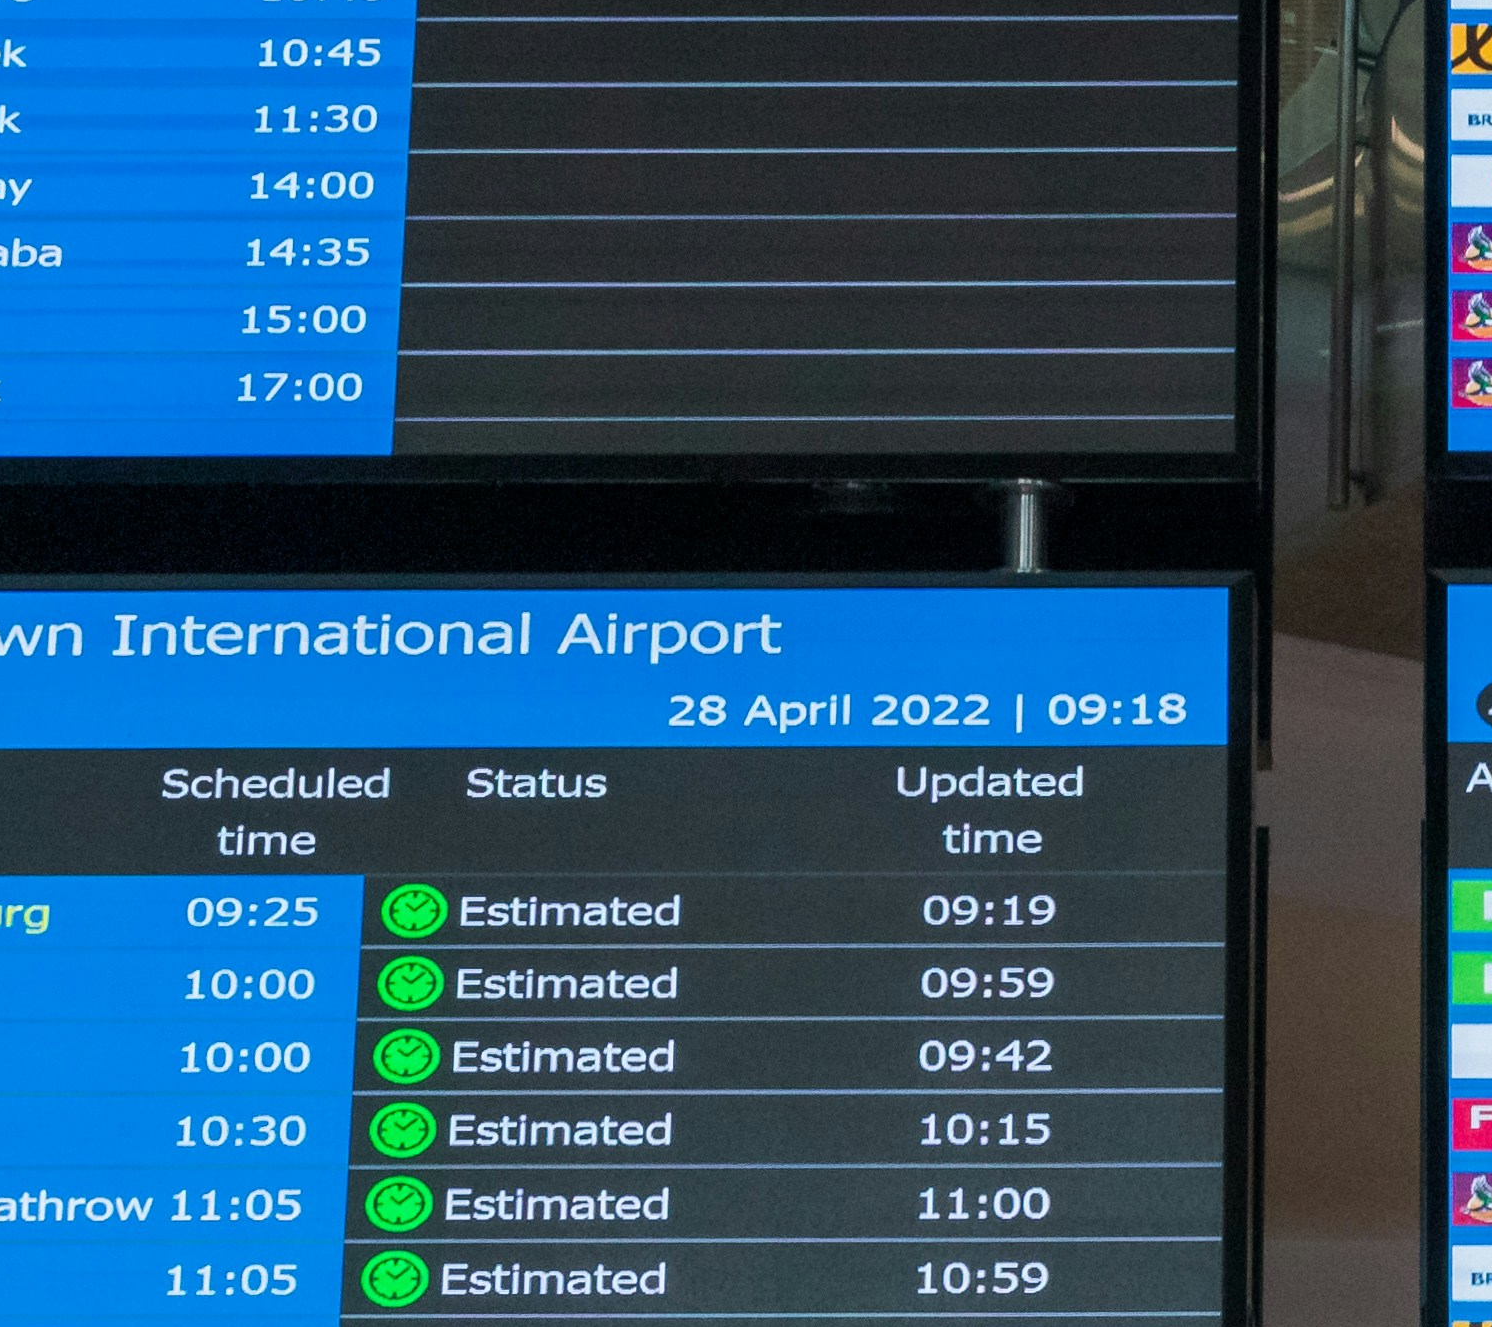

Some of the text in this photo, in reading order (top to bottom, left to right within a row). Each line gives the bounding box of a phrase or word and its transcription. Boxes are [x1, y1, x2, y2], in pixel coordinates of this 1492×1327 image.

[256, 105, 377, 132] 11:30
[247, 239, 369, 266] 14:35
[113, 612, 530, 656] International
[558, 614, 781, 663] Airport
[669, 696, 726, 726] 28
[744, 694, 850, 733] April
[873, 695, 989, 725] 2022
[1049, 694, 1186, 725] 09:18
[186, 970, 314, 999] 10:00
[457, 967, 677, 999] Estimated
[922, 968, 1054, 998] 09:59
[181, 1042, 310, 1072] 10:00
[453, 1040, 674, 1072] Estimated
[920, 1040, 1052, 1071] 09:42
[168, 1265, 296, 1295] 11:05
[442, 1262, 665, 1294] Estimated
[918, 1262, 1049, 1294] 10:59
